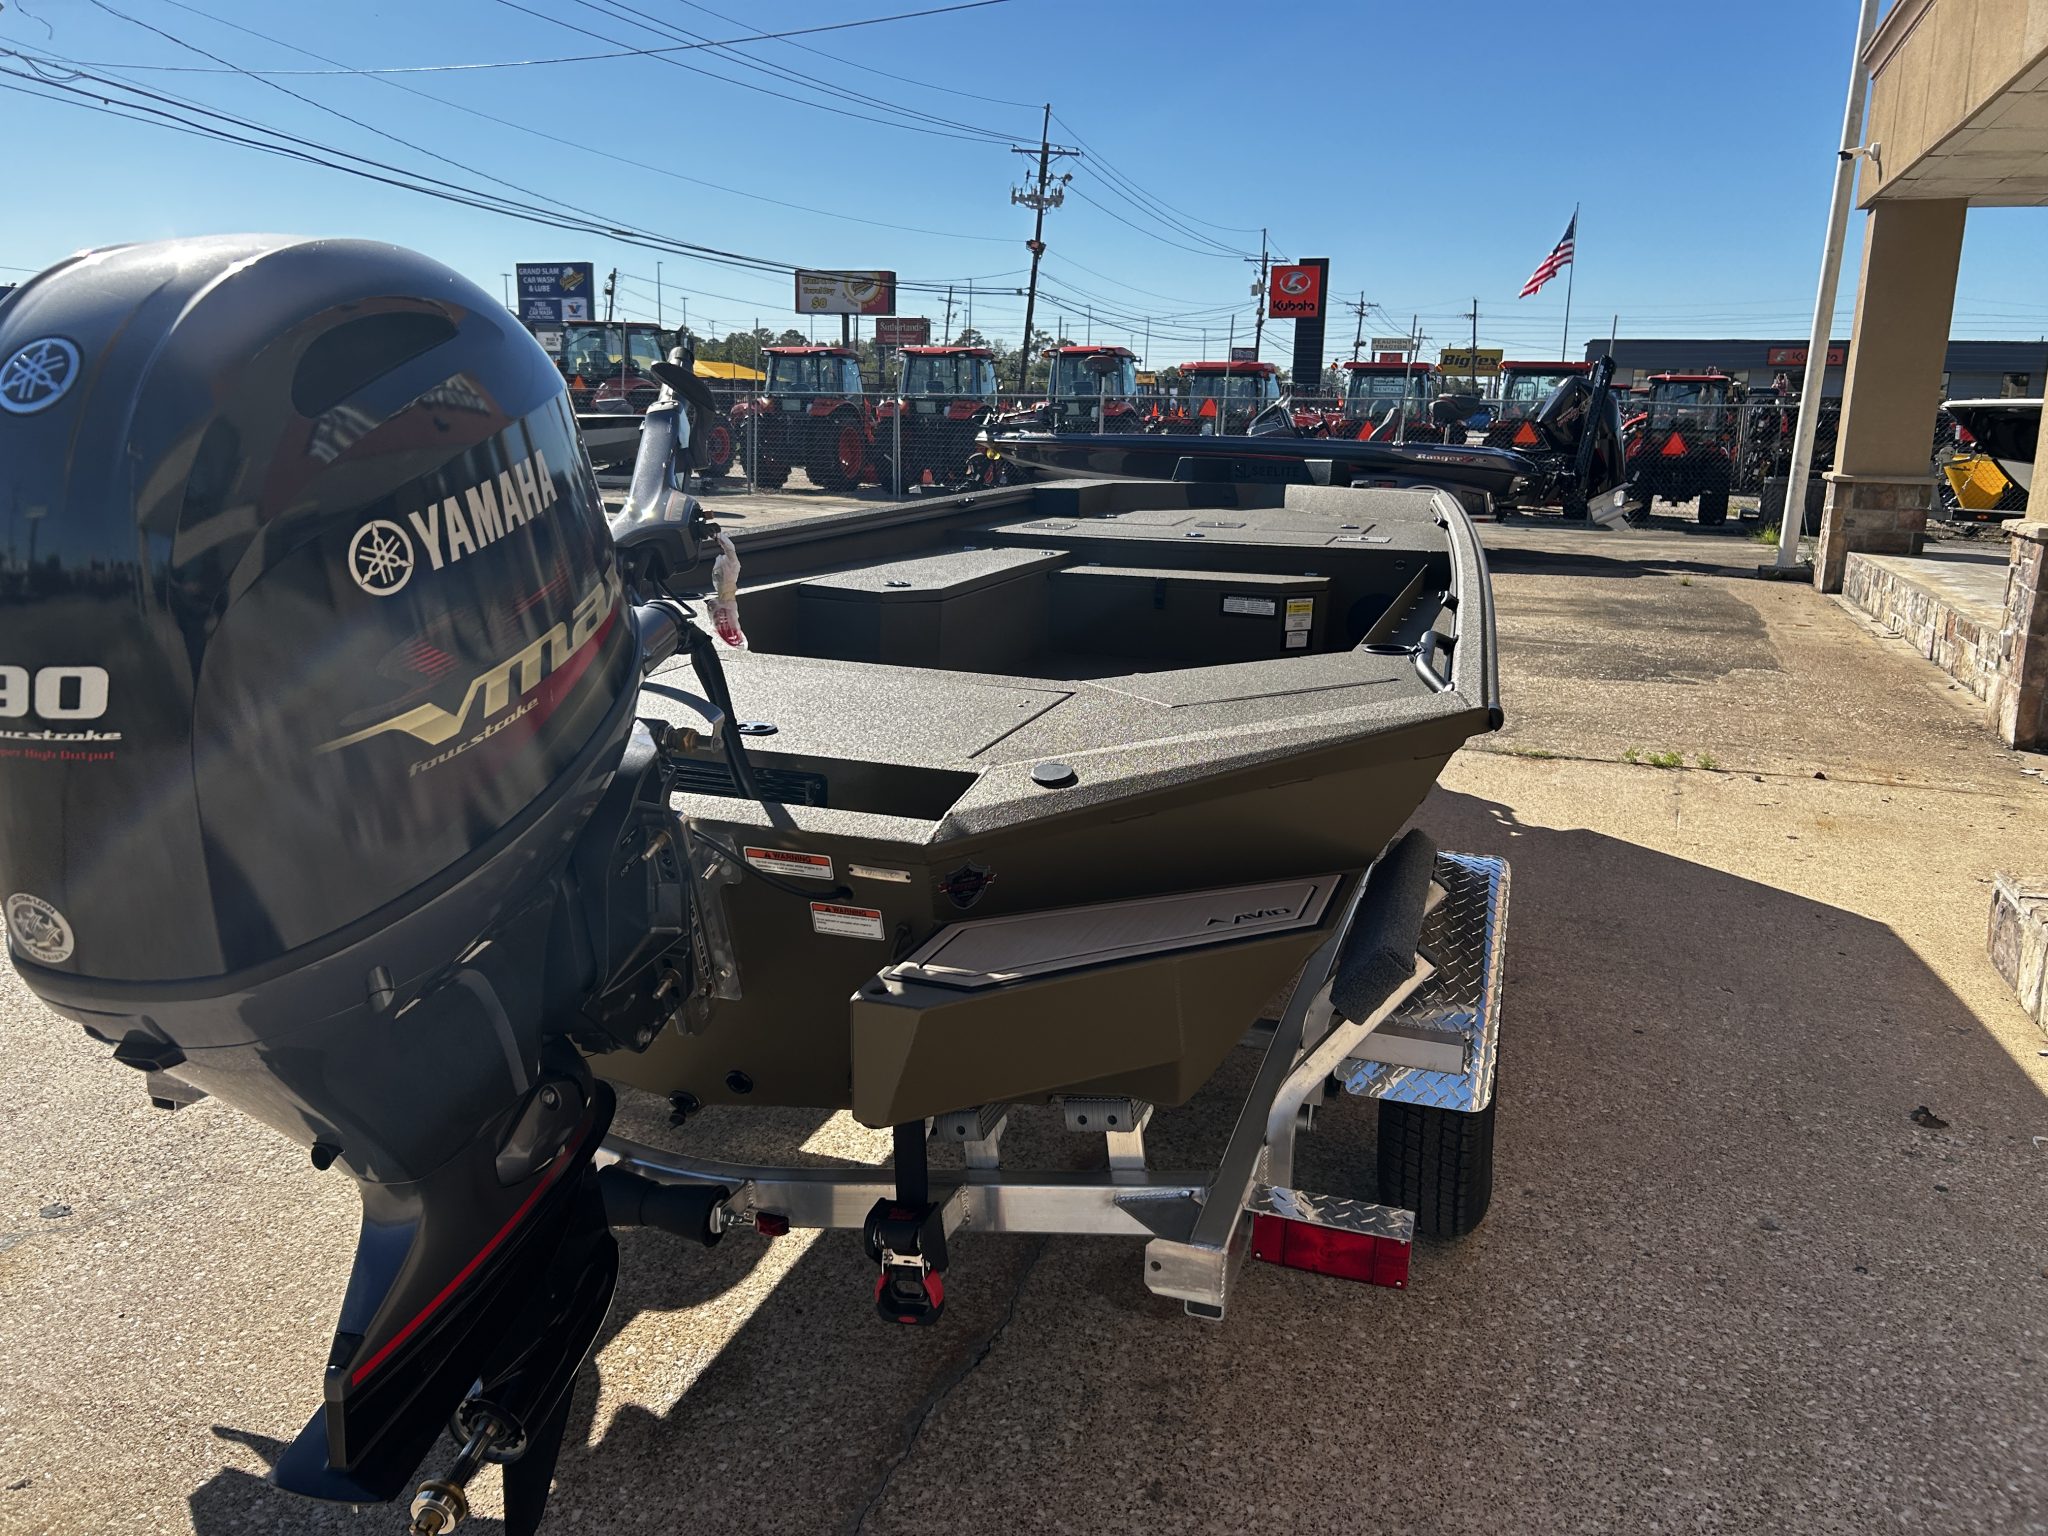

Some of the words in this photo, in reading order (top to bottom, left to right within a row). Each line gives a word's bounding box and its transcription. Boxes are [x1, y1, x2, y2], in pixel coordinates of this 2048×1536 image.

[518, 267, 541, 275] GRAND
[541, 267, 560, 275] SLAM
[522, 276, 536, 284] CAR
[536, 276, 556, 284] WASH
[1272, 300, 1315, 312] Kubota
[408, 449, 559, 571] YAMAHA
[773, 852, 812, 864] WARNING
[832, 906, 867, 917] WARNING
